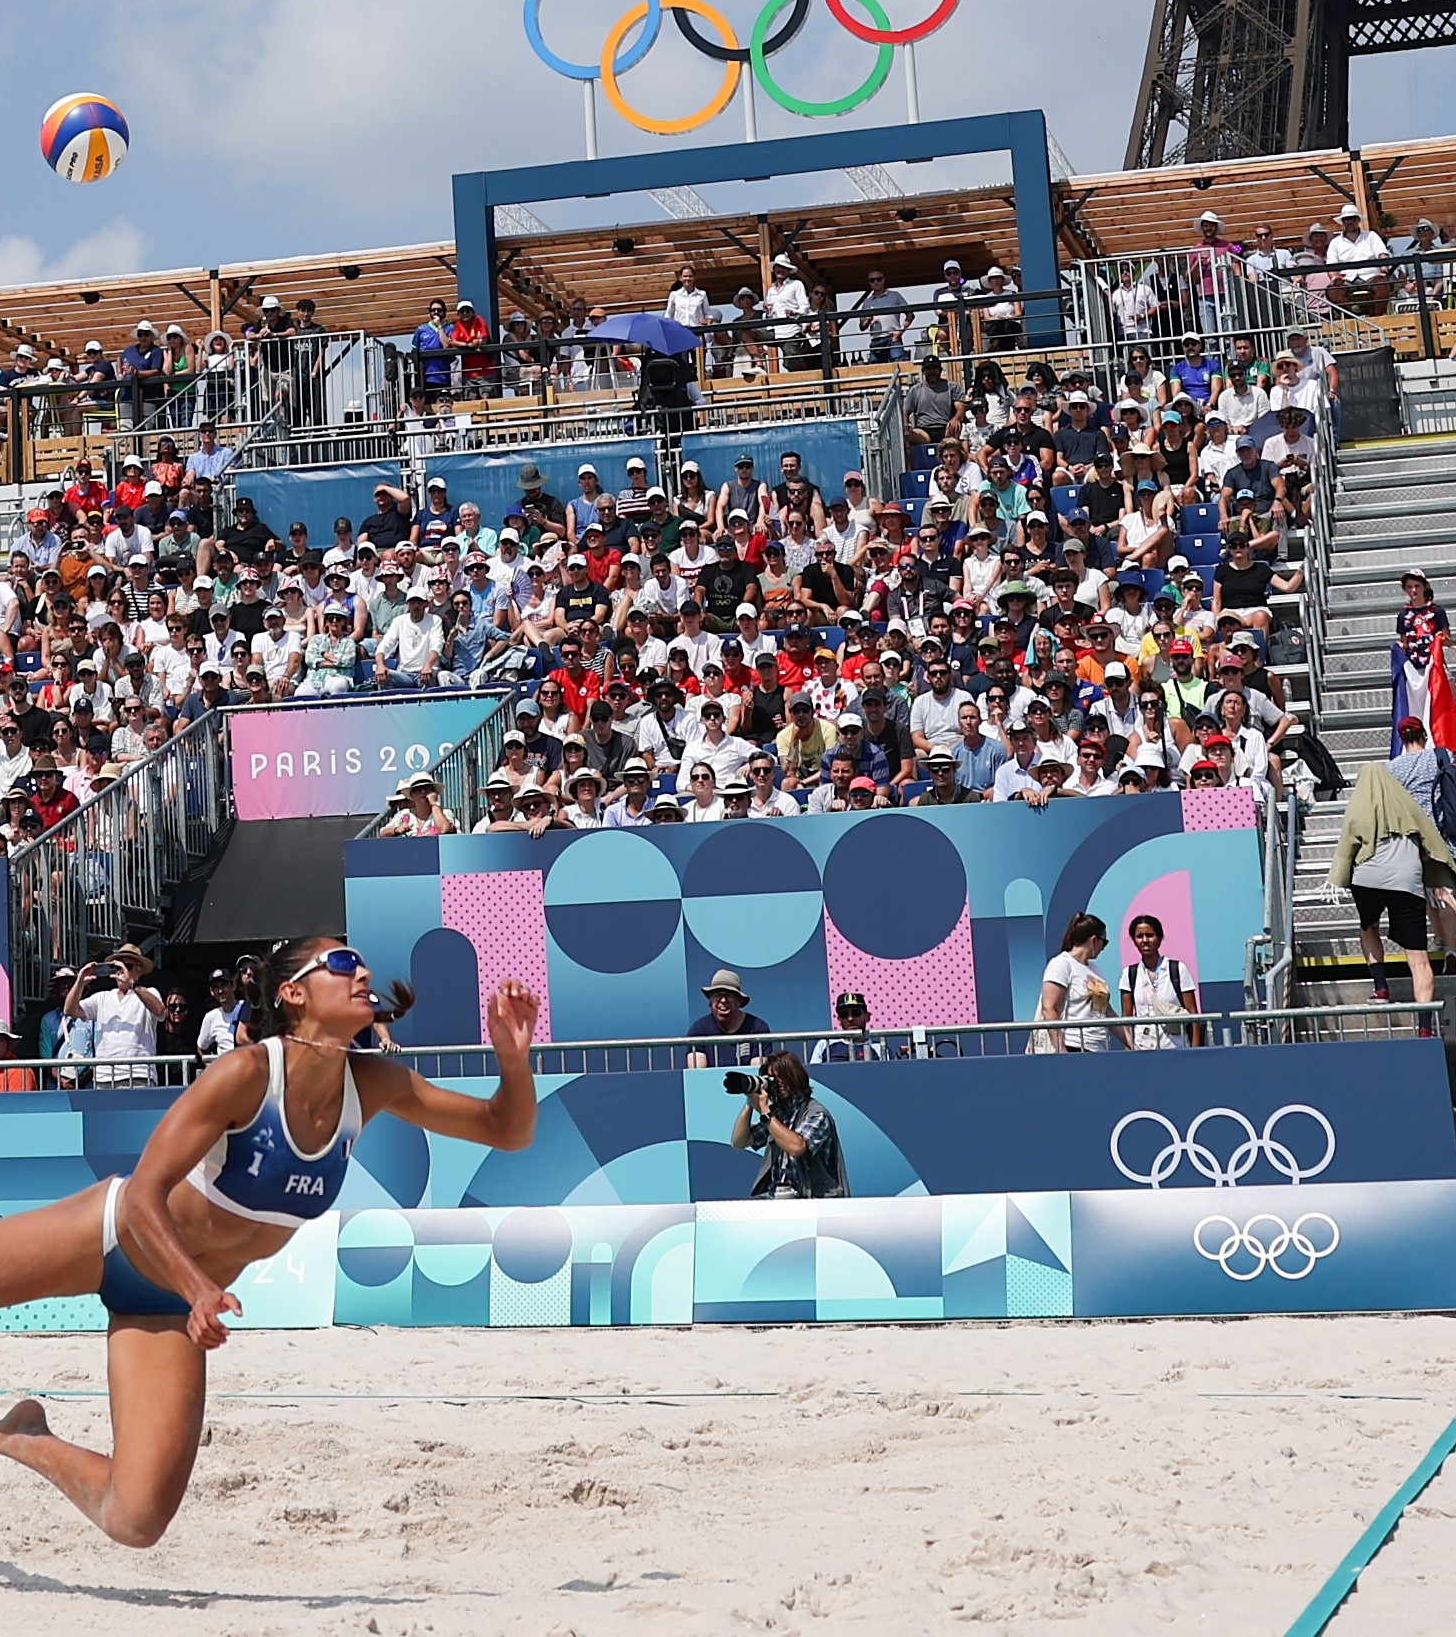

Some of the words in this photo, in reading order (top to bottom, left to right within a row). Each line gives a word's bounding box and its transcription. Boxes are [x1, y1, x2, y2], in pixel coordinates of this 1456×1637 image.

[247, 1151, 264, 1177] 1
[285, 1174, 325, 1196] FRA
[253, 1252, 306, 1284] 24
